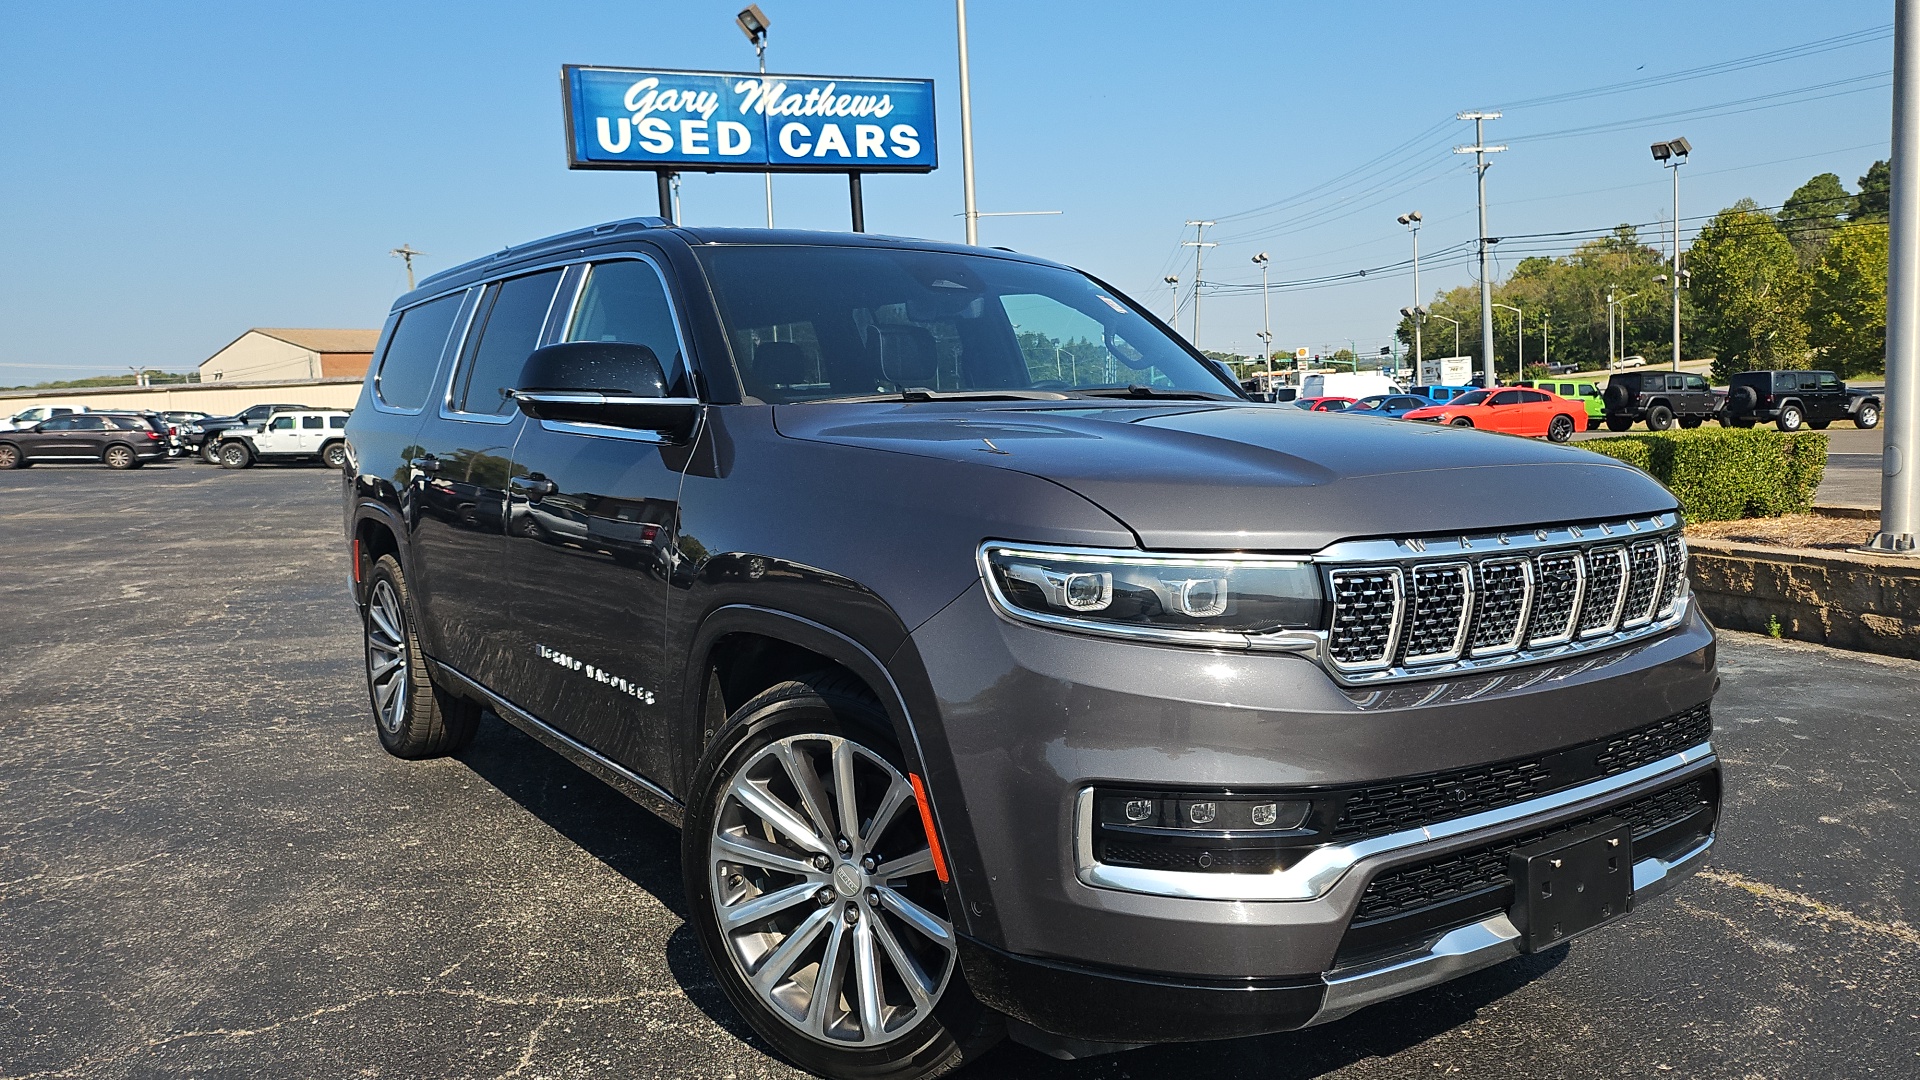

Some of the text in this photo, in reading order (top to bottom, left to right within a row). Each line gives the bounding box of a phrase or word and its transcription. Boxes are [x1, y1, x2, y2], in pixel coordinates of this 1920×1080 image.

[623, 77, 894, 123] Gary Mathews
[596, 116, 921, 159] USED CARS
